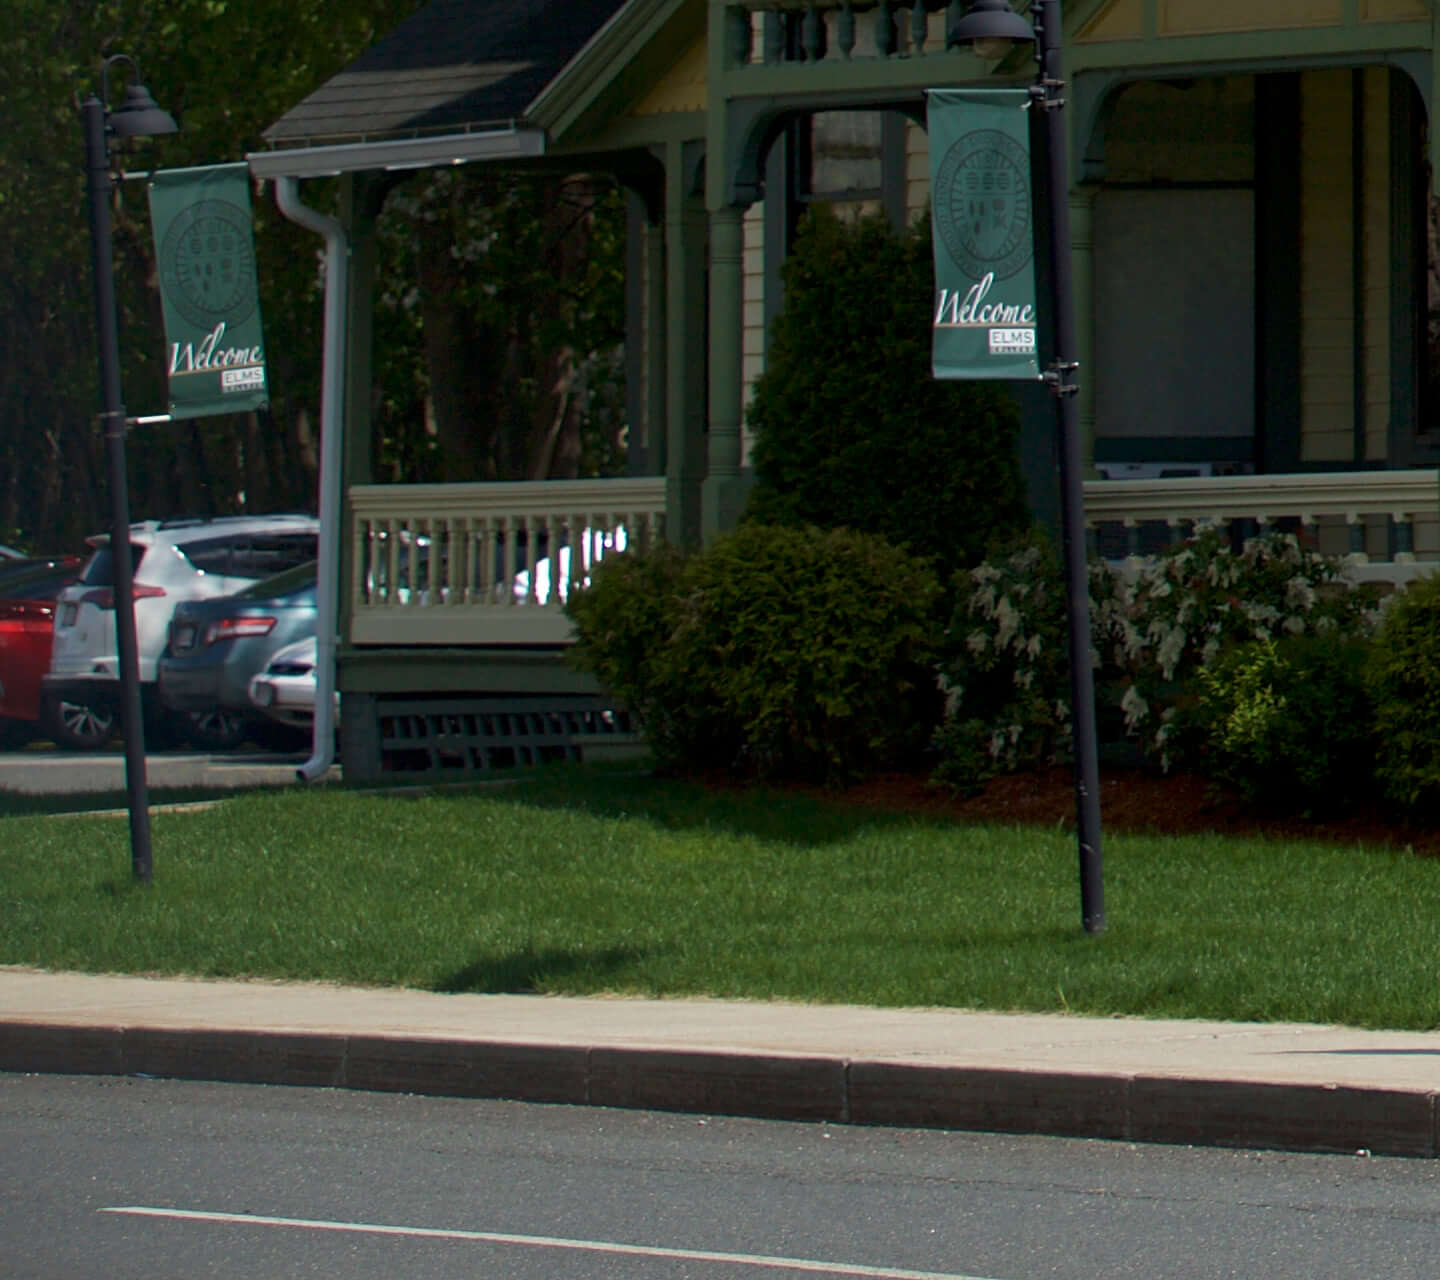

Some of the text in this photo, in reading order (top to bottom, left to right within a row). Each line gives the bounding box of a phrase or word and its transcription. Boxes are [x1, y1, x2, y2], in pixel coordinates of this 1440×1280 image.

[935, 271, 1035, 324] Welcome
[169, 321, 263, 375] Welcome
[992, 331, 1033, 344] ELMS
[225, 369, 262, 384] ELMS
